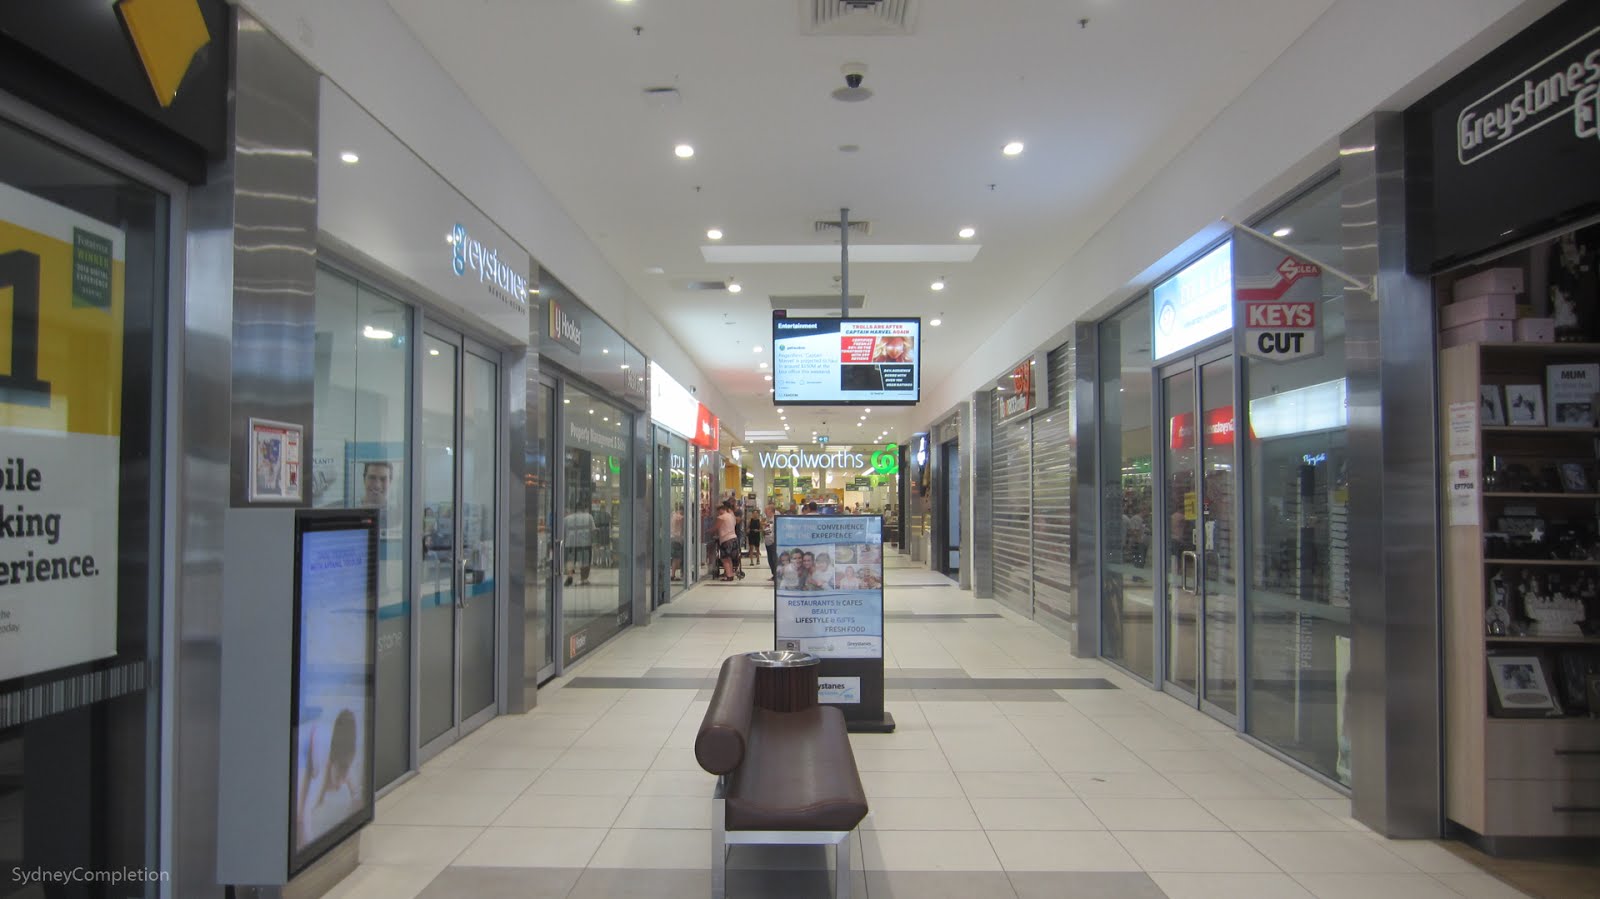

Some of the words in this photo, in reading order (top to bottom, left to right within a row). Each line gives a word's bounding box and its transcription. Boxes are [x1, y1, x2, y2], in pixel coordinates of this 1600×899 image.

[1250, 304, 1313, 326] KEYS
[1257, 332, 1305, 353] CUT
[1561, 370, 1586, 380] MUM
[759, 449, 864, 469] Woolworths
[818, 682, 846, 691] ystanes
